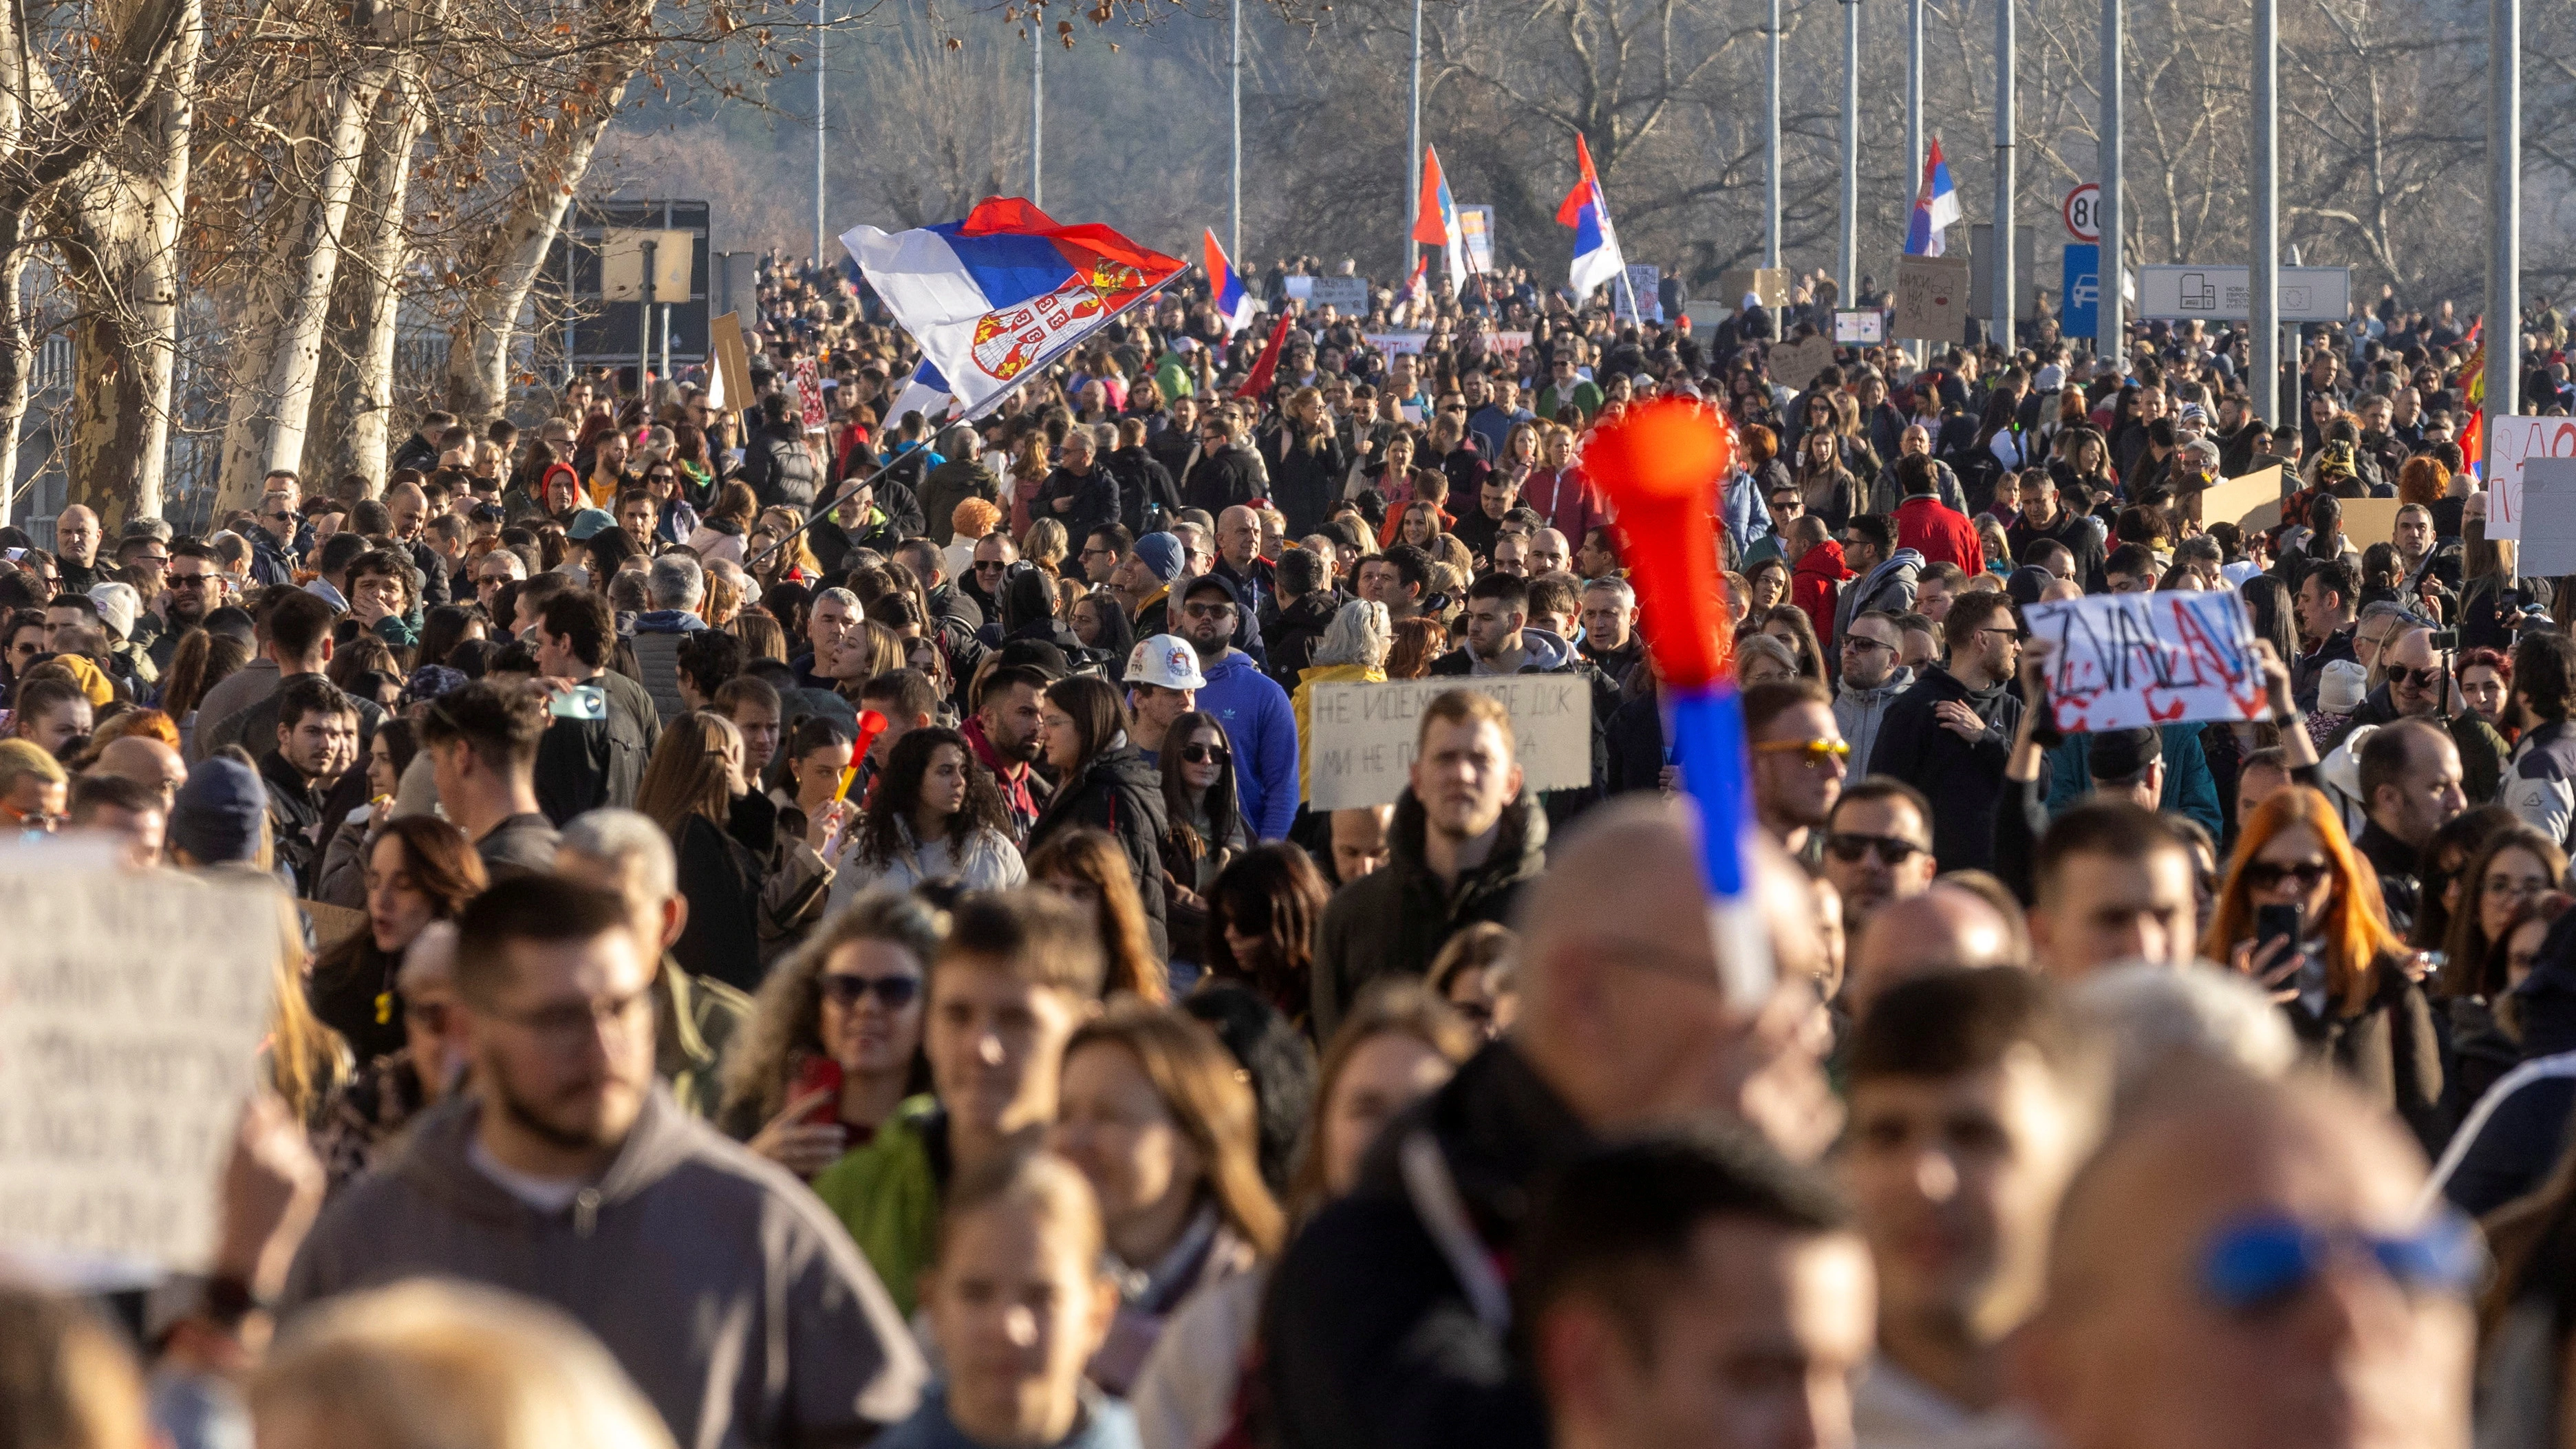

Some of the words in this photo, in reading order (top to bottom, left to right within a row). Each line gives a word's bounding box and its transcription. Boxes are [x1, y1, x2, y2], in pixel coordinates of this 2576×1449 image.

[1316, 691, 1350, 724] НЕ
[1362, 685, 1437, 722] ИДЕМ
[1321, 747, 1352, 777] МИ
[1362, 743, 1387, 773] НЕ
